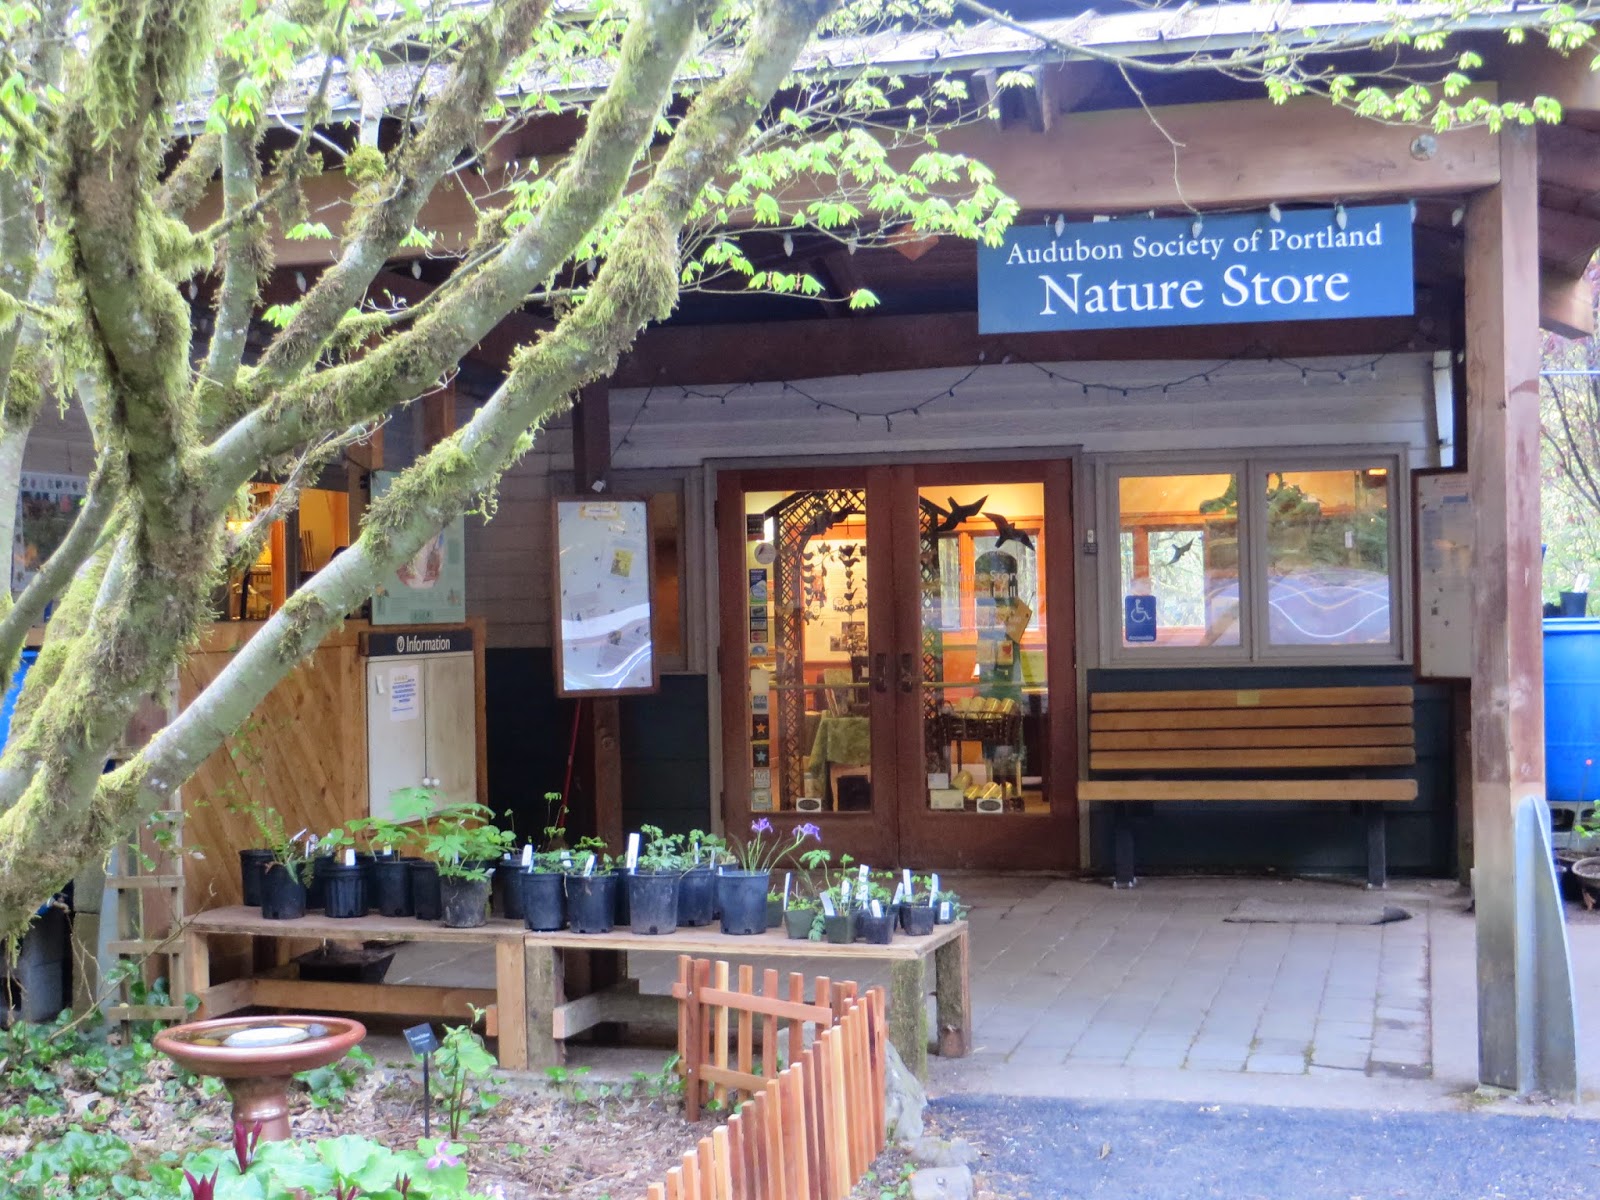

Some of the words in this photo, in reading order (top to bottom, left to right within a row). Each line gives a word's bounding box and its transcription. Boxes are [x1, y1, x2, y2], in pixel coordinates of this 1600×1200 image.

[1005, 239, 1123, 265] Audubon
[1132, 233, 1223, 261] Society
[1233, 230, 1262, 253] of
[1269, 221, 1382, 251] Portland
[1039, 273, 1204, 315] Nature
[1221, 264, 1350, 307] Store
[406, 635, 451, 652] Information
